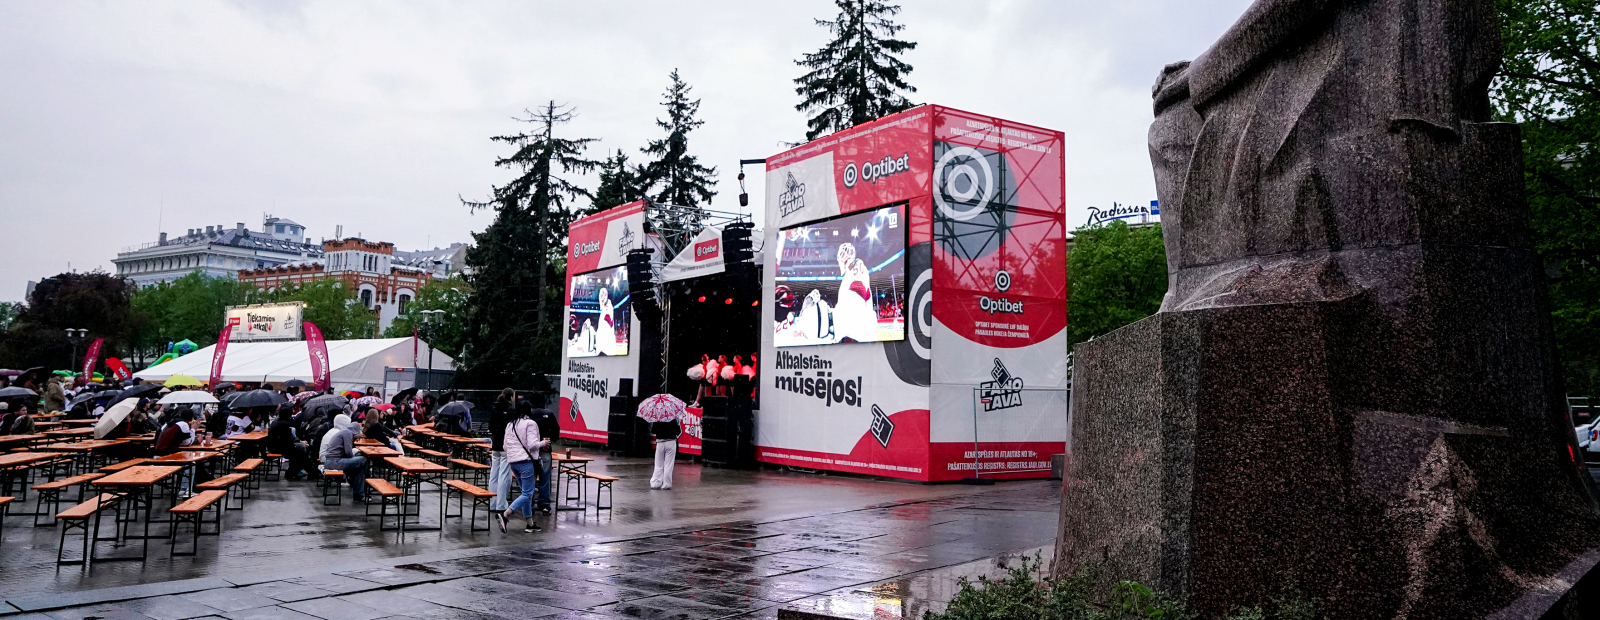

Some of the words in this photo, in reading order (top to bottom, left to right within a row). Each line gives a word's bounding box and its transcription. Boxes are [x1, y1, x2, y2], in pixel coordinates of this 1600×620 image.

[862, 153, 909, 184] Optibet
[779, 182, 805, 207] FANO
[780, 196, 804, 218] TAVA
[1087, 201, 1149, 226] Radisson
[581, 240, 600, 257] Optibet
[980, 296, 1024, 314] Optibet
[568, 360, 595, 373] Atbalstām
[776, 350, 832, 370] Atbalstām
[568, 374, 608, 399] mūsējos!
[775, 371, 862, 407] mūsējos!
[981, 377, 1023, 398] FANO
[981, 392, 1022, 412] TAVA
[964, 450, 994, 459] AZARSPĒLES
[1021, 450, 1027, 458] NO
